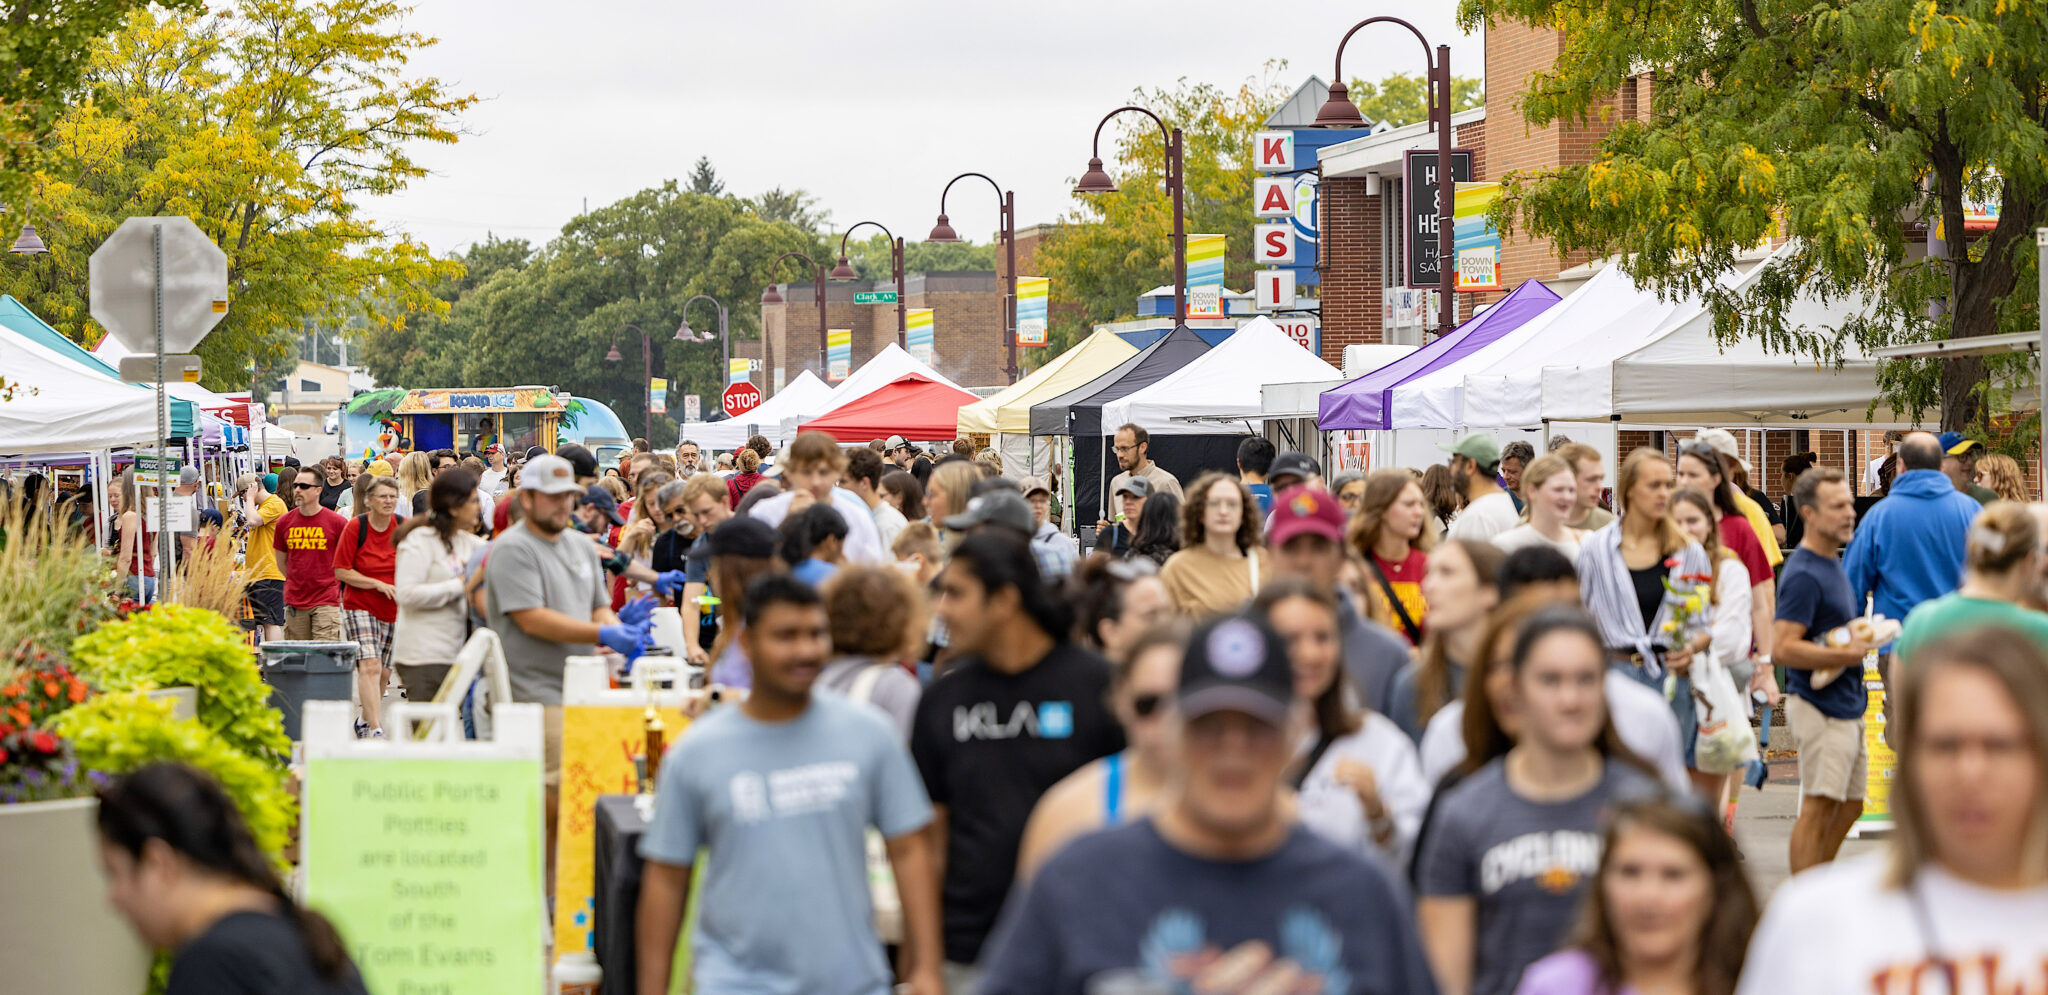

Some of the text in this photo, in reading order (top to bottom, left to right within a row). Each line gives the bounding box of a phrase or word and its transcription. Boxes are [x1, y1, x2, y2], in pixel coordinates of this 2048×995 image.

[1262, 138, 1290, 303] KASI
[1461, 257, 1492, 266] DOWN
[1461, 265, 1493, 274] TOWN
[1462, 274, 1493, 283] AMES
[856, 292, 878, 300] Clark
[450, 393, 490, 408] KONA
[491, 393, 515, 407] ICE
[726, 392, 759, 410] STOP
[288, 526, 325, 538] IOWA
[286, 538, 328, 550] STATE
[354, 781, 500, 801] Public Porta
[384, 814, 468, 834] Potties
[360, 848, 487, 867] are located
[392, 880, 460, 899] South
[389, 911, 457, 929] of the
[420, 943, 496, 966] Evans
